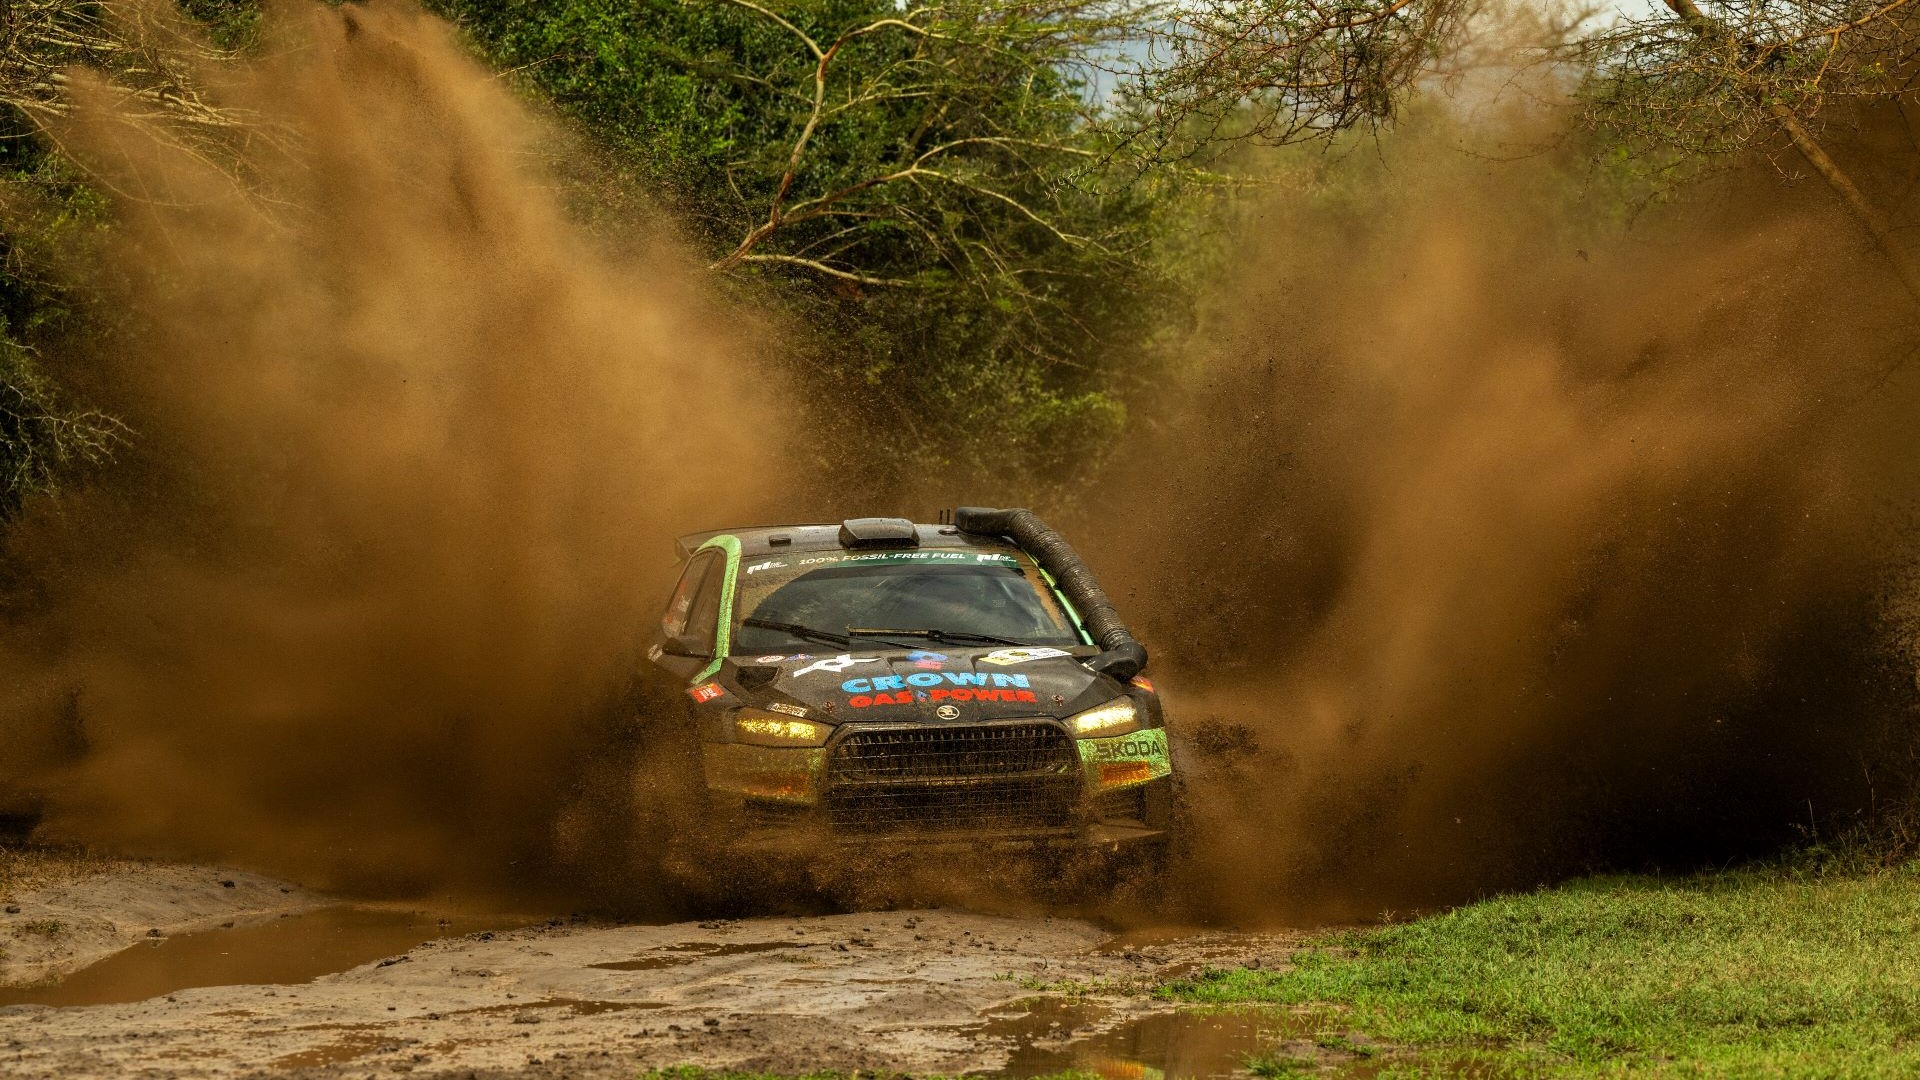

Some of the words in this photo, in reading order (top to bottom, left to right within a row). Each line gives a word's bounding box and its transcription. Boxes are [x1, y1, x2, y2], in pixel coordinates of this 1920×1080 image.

[798, 556, 839, 566] 100%
[842, 553, 930, 562] FOSSIL-FREE
[841, 672, 1031, 693] CROWN
[848, 689, 914, 709] GAS
[929, 687, 1038, 703] POWER
